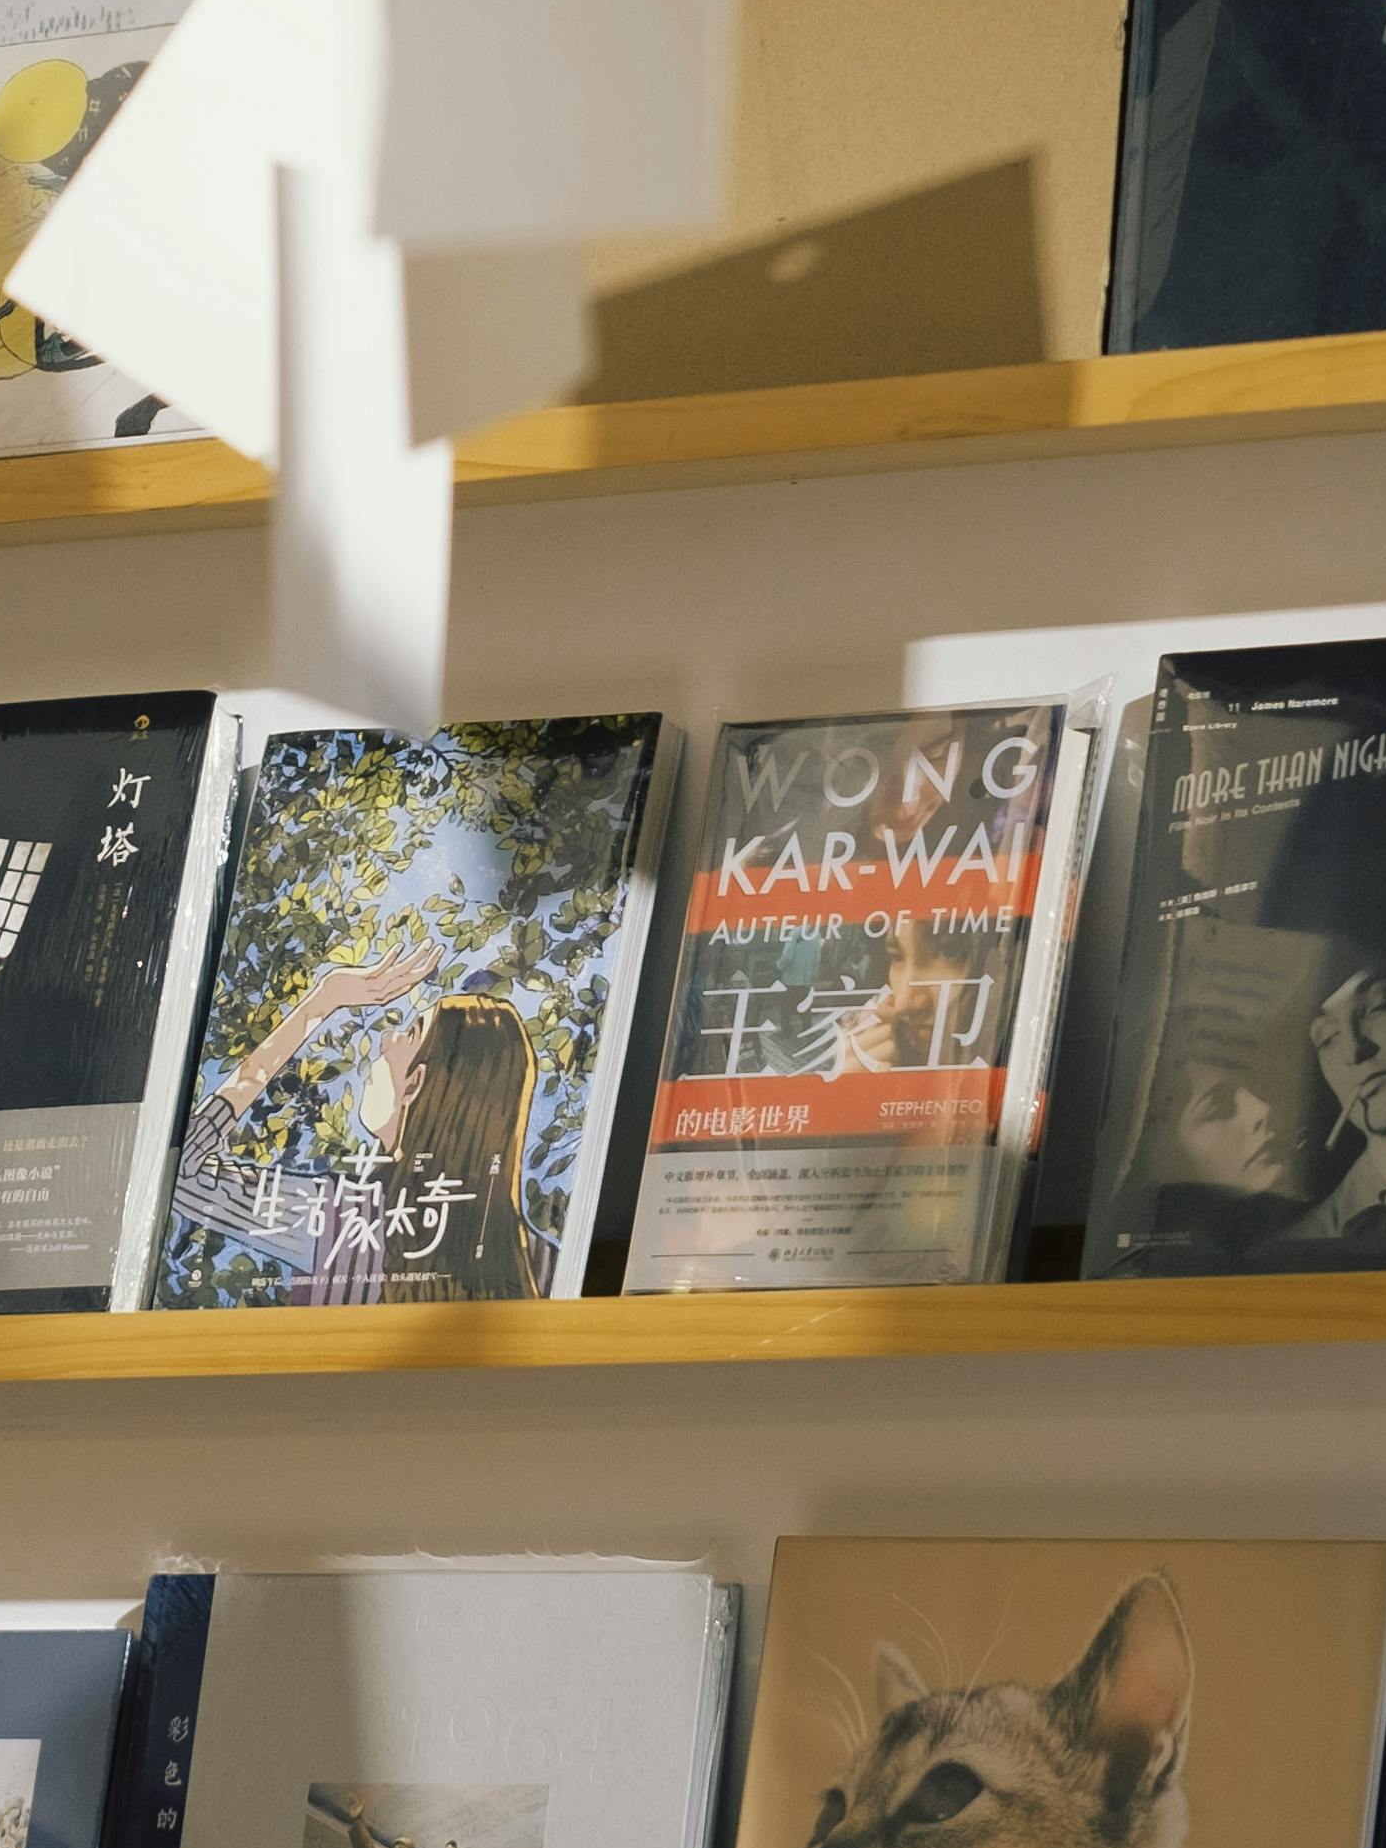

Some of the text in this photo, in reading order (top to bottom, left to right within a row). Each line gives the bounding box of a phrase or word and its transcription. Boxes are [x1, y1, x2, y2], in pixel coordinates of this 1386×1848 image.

[737, 736, 1039, 814] WONG
[1172, 763, 1251, 814] MORE
[1256, 747, 1324, 795] THAN
[97, 767, 151, 867] 灯塔
[716, 822, 1026, 897] KAR-WAI
[709, 906, 1014, 946] AUTEUR OF TIME
[677, 974, 995, 1082] 王家卫
[674, 1105, 811, 1137] 的电影世界
[879, 1100, 982, 1117] STEPHEN TEO
[248, 1142, 478, 1270] 生活蒙太奇
